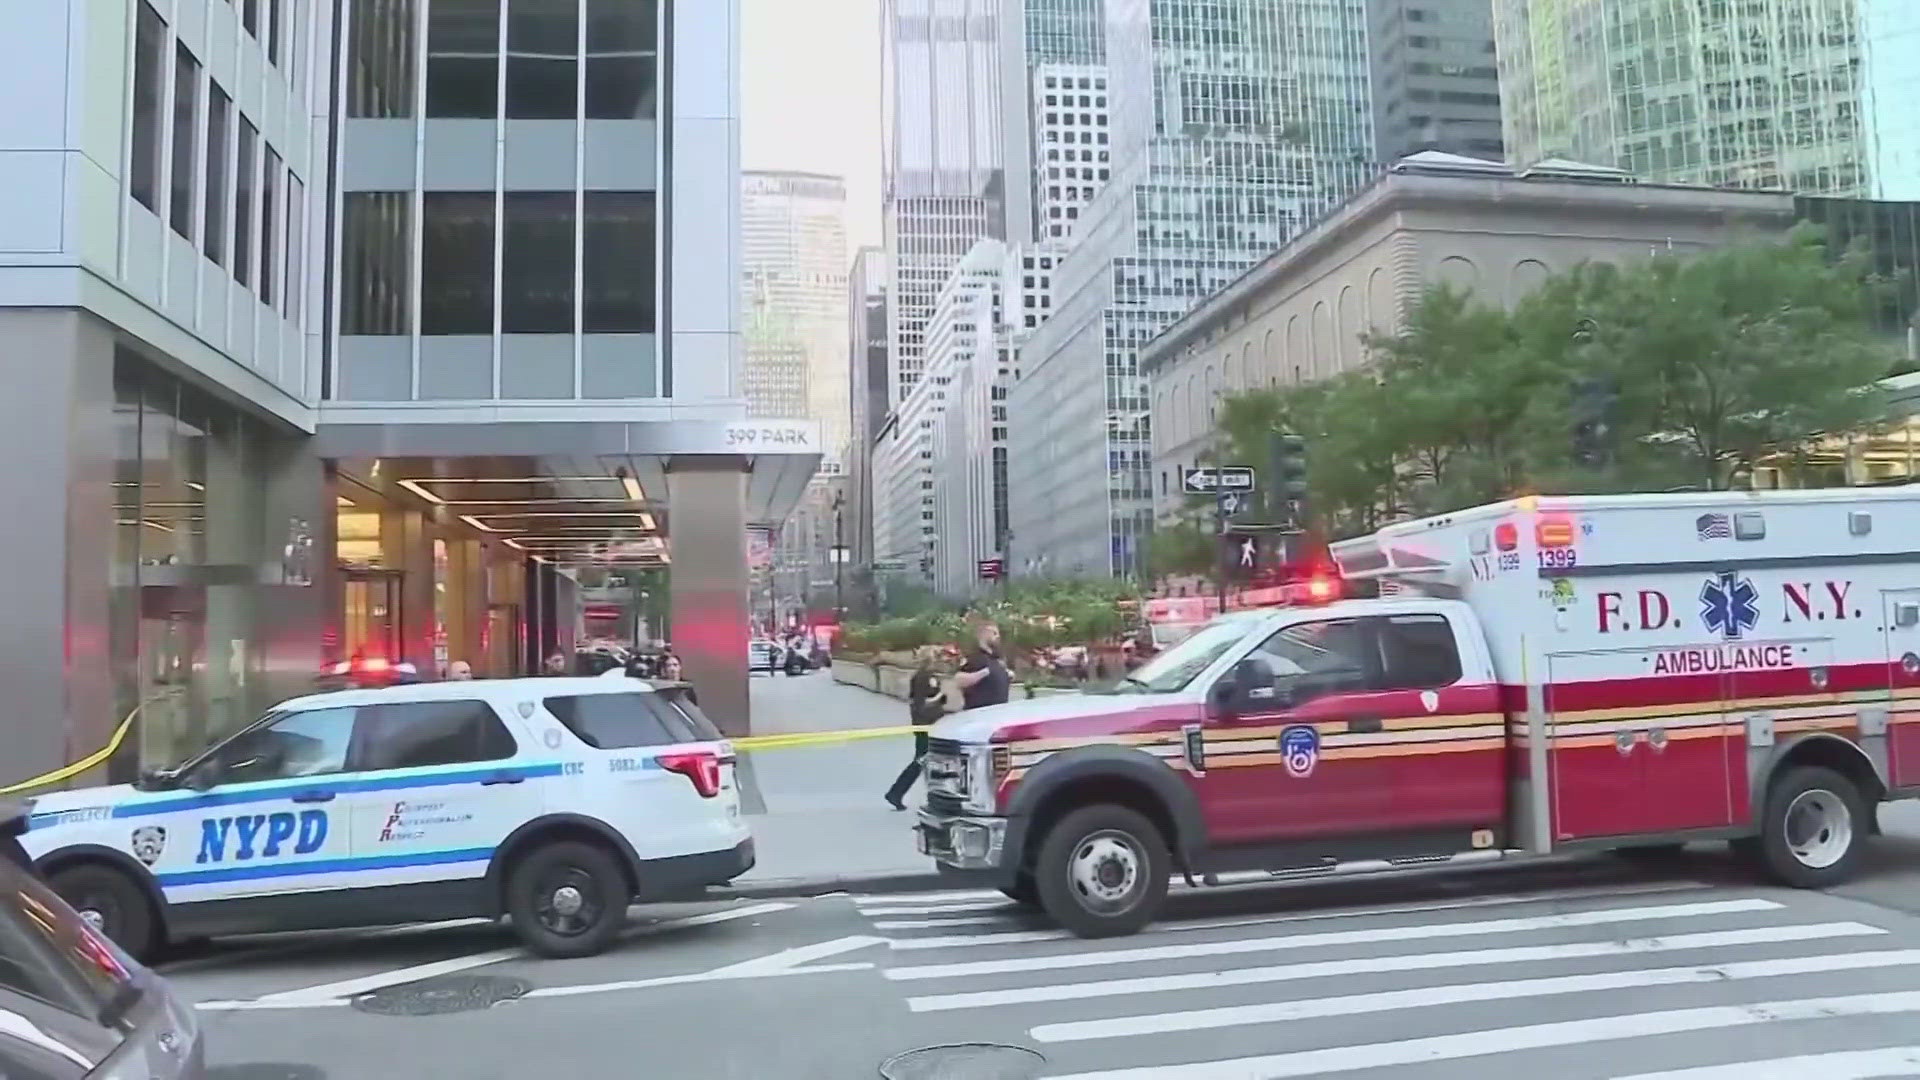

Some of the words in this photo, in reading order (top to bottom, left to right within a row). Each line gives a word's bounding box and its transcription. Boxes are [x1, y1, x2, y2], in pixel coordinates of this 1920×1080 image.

[726, 429, 757, 445] 399
[761, 429, 808, 445] PARK
[1538, 549, 1576, 568] 1399
[1598, 590, 1681, 633] F.D.
[1782, 580, 1861, 622] N.Y.
[1654, 645, 1792, 674] AMBULANCE
[196, 809, 328, 864] NYPD
